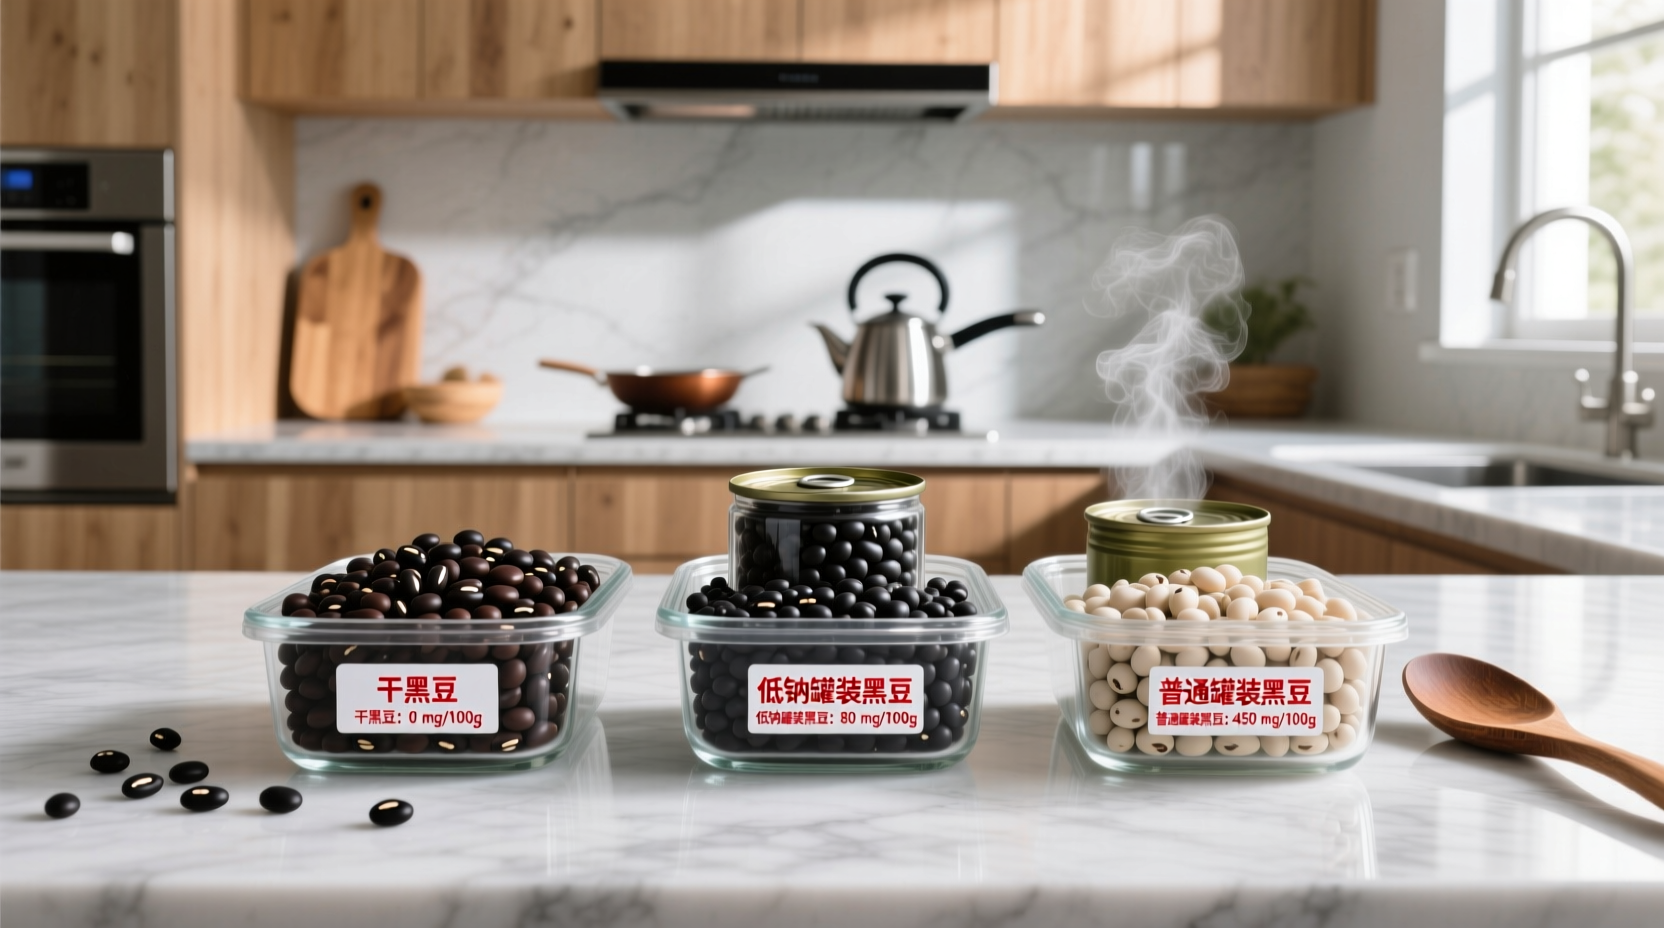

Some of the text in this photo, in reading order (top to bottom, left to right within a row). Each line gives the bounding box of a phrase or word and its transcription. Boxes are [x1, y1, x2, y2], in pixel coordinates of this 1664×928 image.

[376, 675, 459, 704] 干黑豆
[756, 675, 913, 705] 低钠罐装黑豆
[1158, 676, 1312, 706] 普通罐装黑豆
[408, 710, 417, 724] 0
[422, 710, 483, 729] mg/100g
[840, 711, 857, 725] 80
[860, 711, 918, 728] mg/100g
[1231, 712, 1258, 726] 450
[1261, 712, 1317, 730] mg/100g
